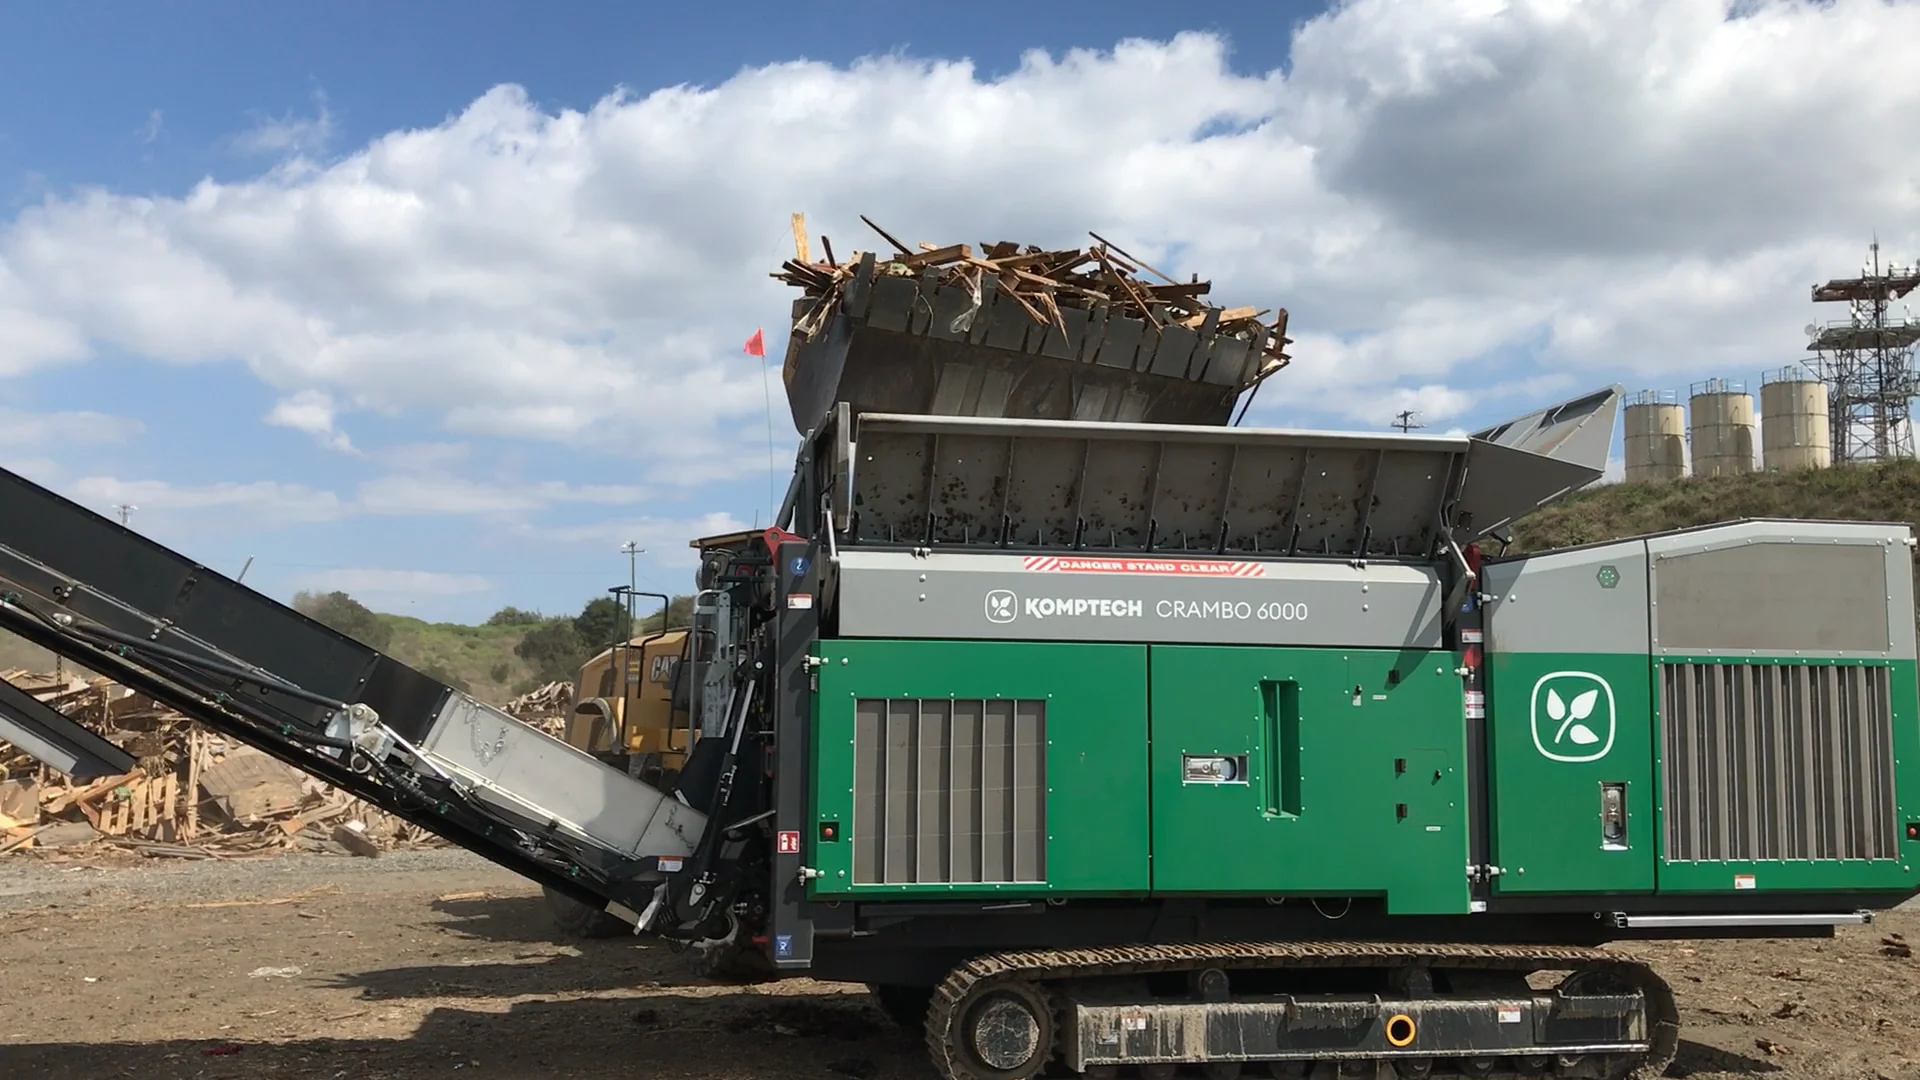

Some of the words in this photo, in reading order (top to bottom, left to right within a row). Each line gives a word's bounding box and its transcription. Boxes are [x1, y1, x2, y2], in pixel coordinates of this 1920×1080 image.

[1060, 561, 1123, 571] DANGER
[1127, 562, 1176, 572] STAND
[1180, 563, 1231, 573] CLEAR
[1025, 598, 1143, 619] KOMPTECH
[1156, 599, 1252, 620] CRAMBO
[1256, 602, 1308, 621] 6000
